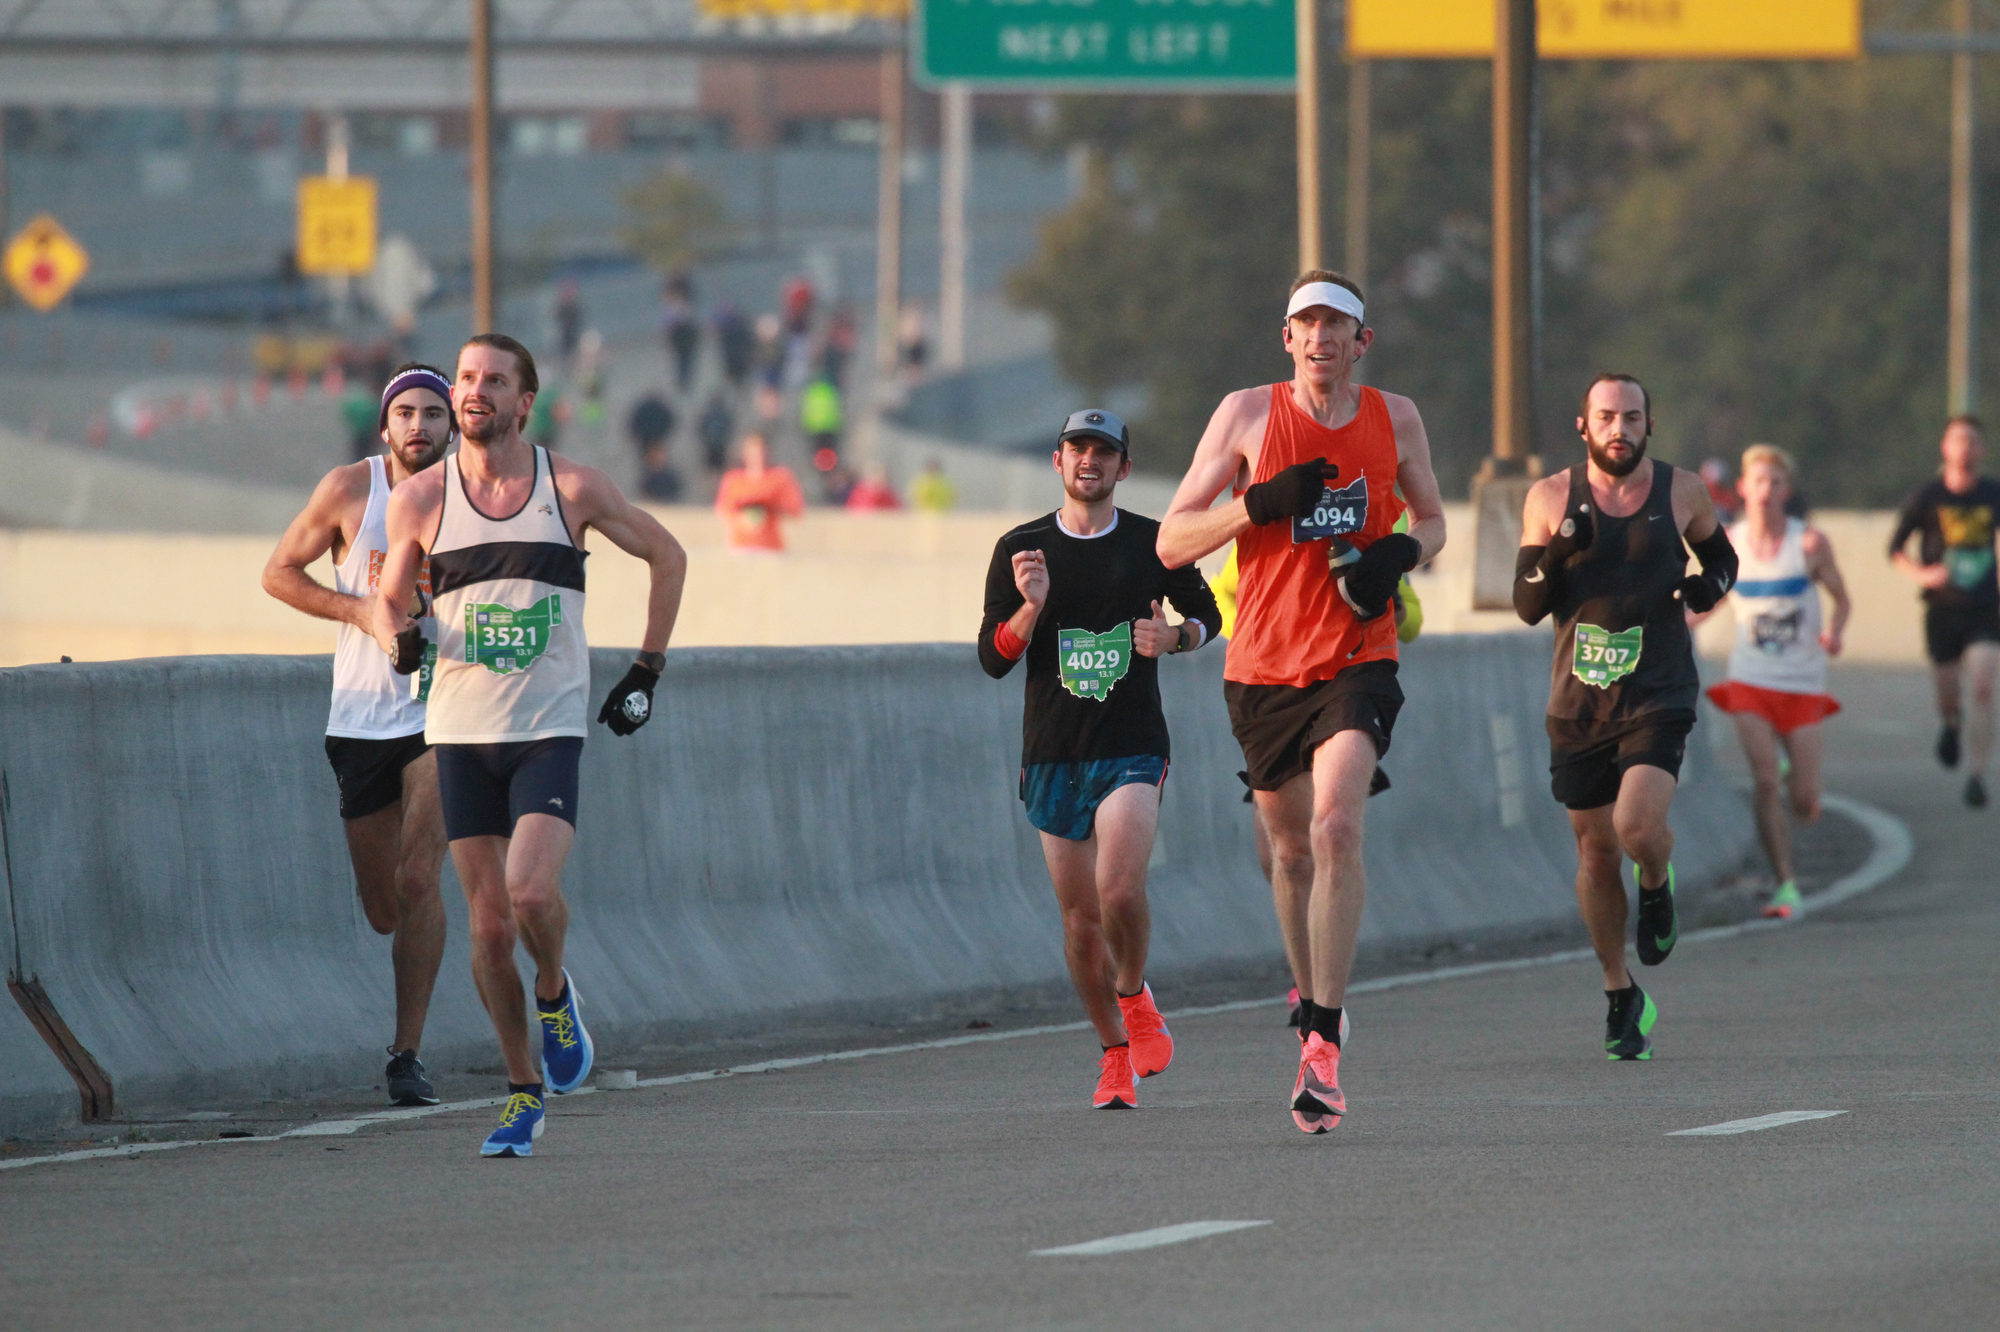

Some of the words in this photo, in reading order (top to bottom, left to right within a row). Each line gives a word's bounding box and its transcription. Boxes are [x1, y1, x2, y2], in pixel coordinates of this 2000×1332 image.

[1000, 23, 1108, 61] NEXT
[1129, 24, 1230, 62] LEFT
[483, 626, 536, 646] 3521
[1067, 650, 1120, 670] 4029
[1581, 644, 1629, 664] 3707
